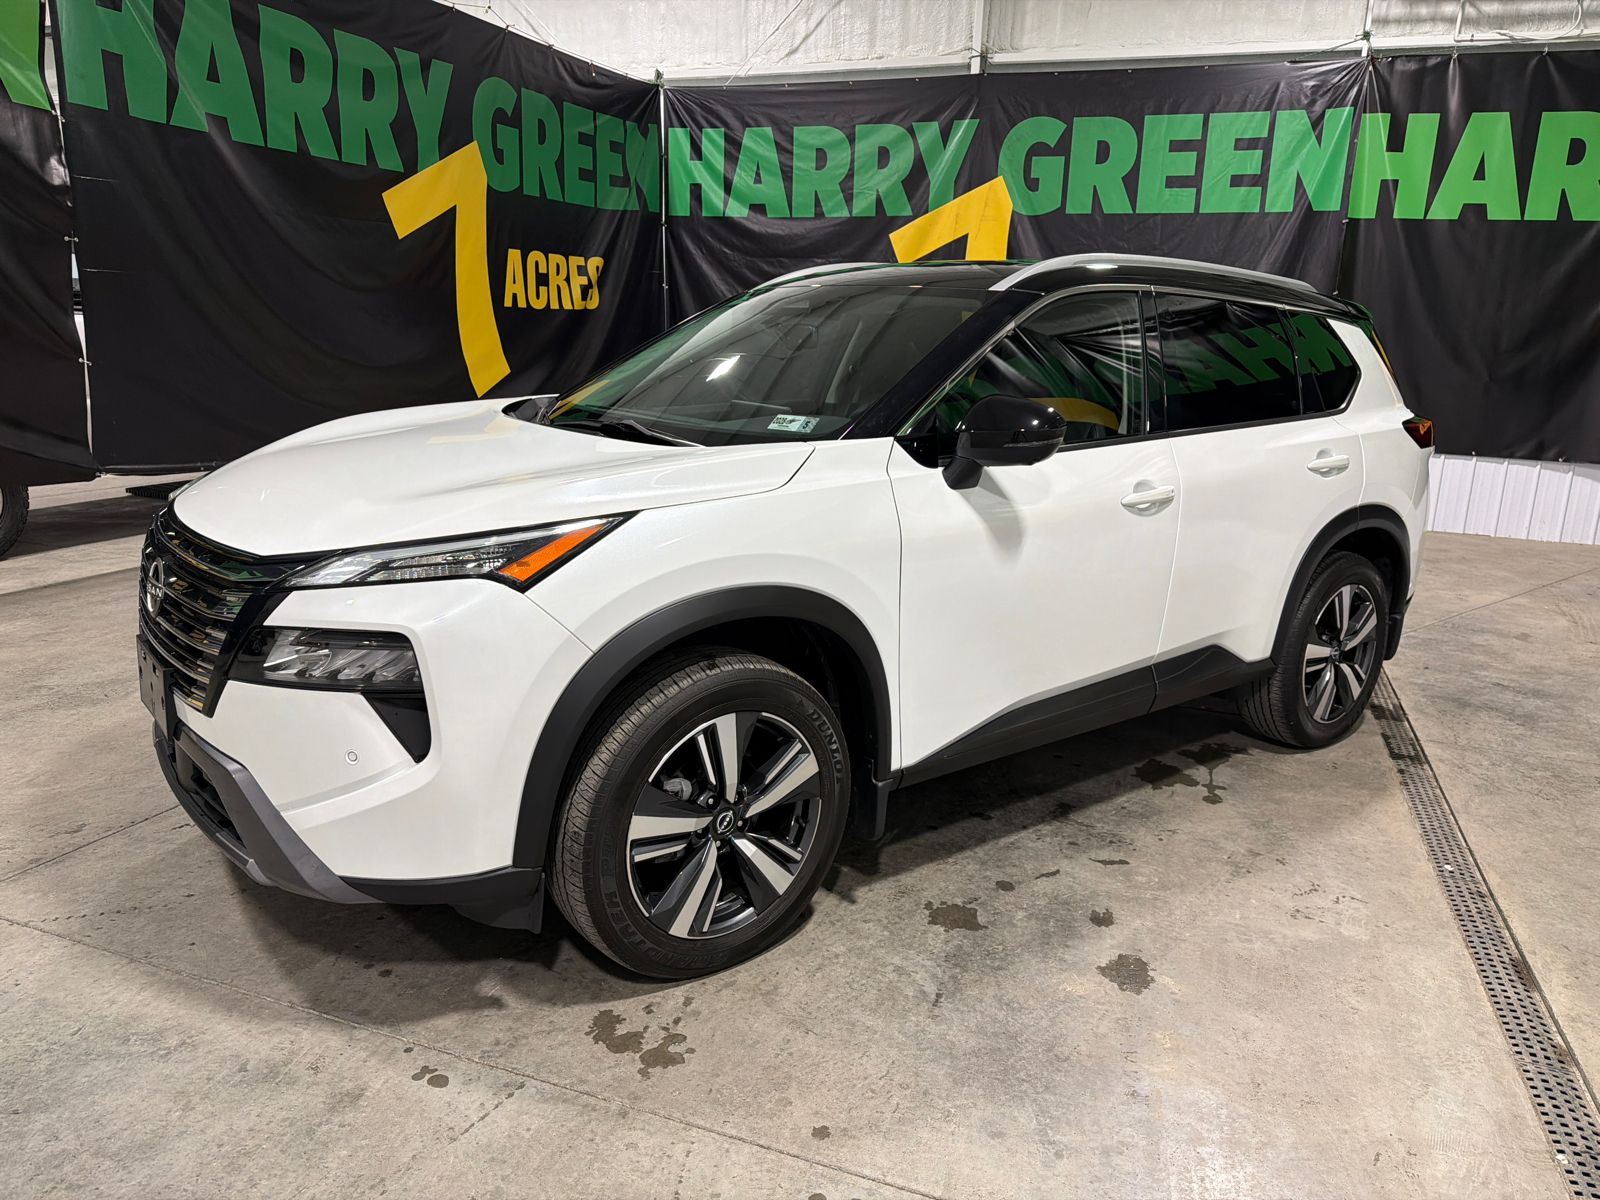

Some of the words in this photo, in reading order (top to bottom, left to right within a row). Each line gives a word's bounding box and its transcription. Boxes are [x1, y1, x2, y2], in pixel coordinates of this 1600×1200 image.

[55, 0, 453, 173] HARRY
[473, 76, 660, 213] GREEN
[668, 118, 980, 218] HARRY
[998, 106, 1355, 216] GREEN
[381, 140, 511, 398] 7
[503, 248, 605, 310] ACRES
[802, 421, 811, 429] 5
[806, 707, 845, 786] DUNLOP
